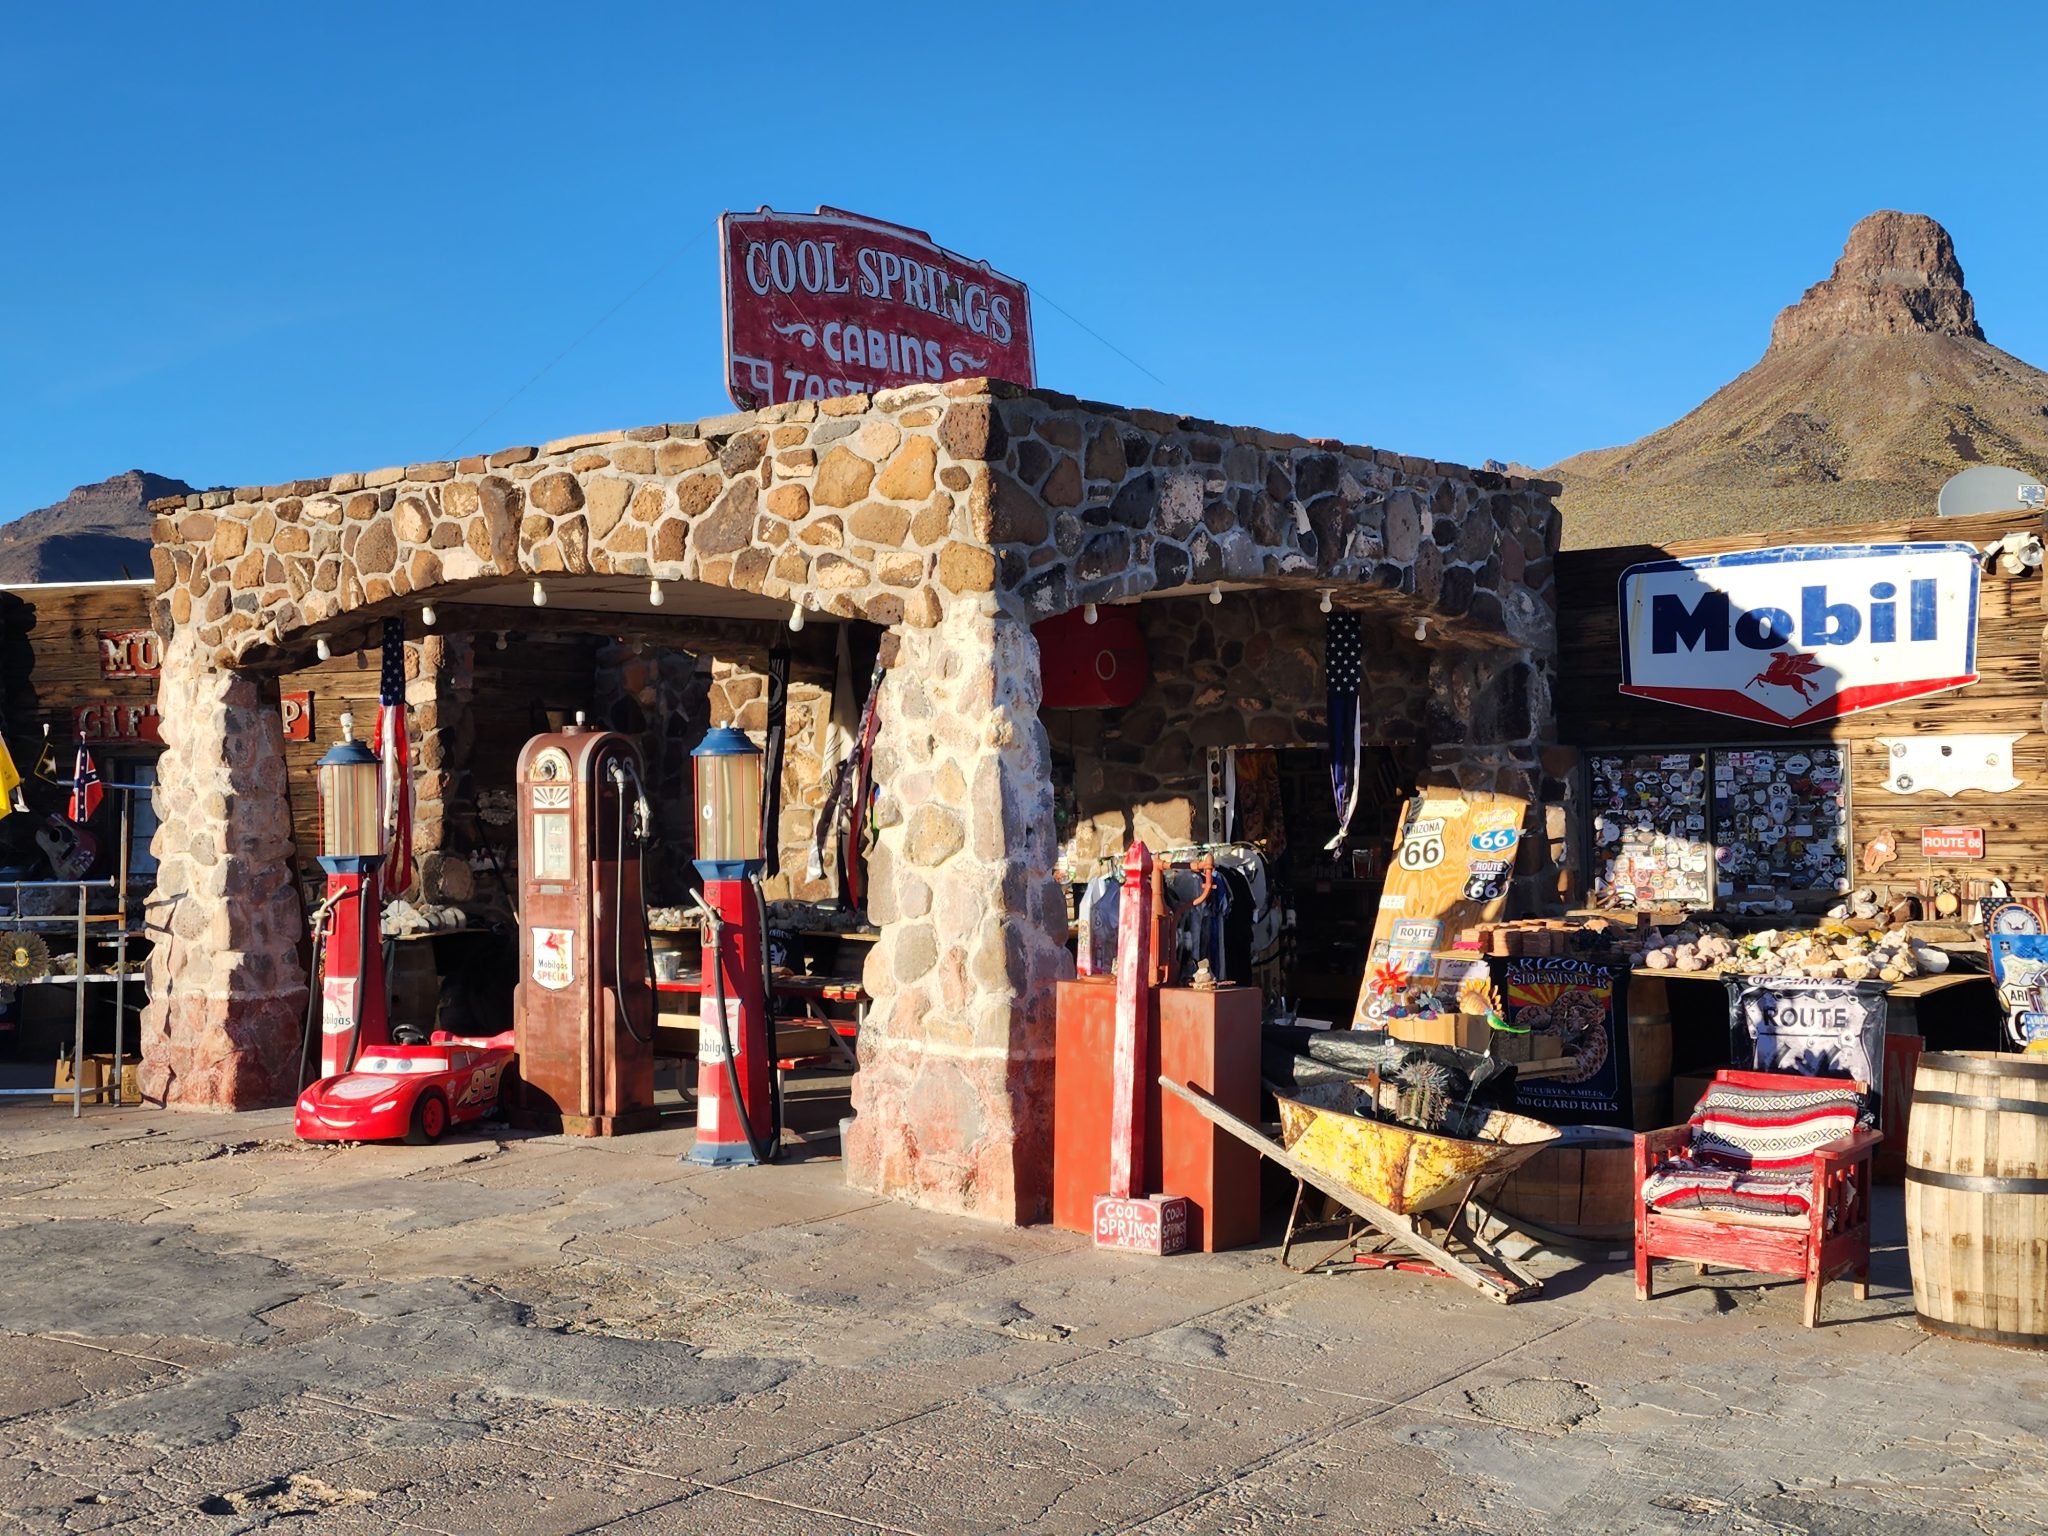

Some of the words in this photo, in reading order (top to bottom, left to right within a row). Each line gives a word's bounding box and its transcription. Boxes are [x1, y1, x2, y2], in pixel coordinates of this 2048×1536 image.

[745, 239, 849, 296] COOL
[856, 246, 1013, 345] SPRINGS
[822, 321, 943, 381] CABINS
[1652, 578, 1938, 655] Mobil
[1772, 785, 1788, 795] SK
[1405, 822, 1440, 836] ARIZONA
[1480, 830, 1508, 849] 66
[1924, 837, 1965, 848] ROUTE
[1968, 838, 1981, 849] 66
[1404, 838, 1439, 866] 66
[1475, 861, 1503, 872] ROUTE
[1470, 880, 1498, 898] 66
[1400, 927, 1435, 938] ROUTE
[538, 959, 568, 972] Mobilgas
[1505, 958, 1614, 979] ARIZONA
[537, 970, 569, 982] SPECIAL
[1512, 972, 1608, 989] SIDEWINDER
[1762, 1007, 1847, 1028] ROUTE
[471, 1065, 497, 1105] 95
[1516, 1096, 1531, 1105] NO
[1533, 1098, 1578, 1109] GUARD
[1581, 1102, 1618, 1111] RAILS
[1105, 1203, 1142, 1220] COOL
[1165, 1206, 1183, 1222] COOL
[1099, 1218, 1157, 1239] SPRINGS
[1117, 1236, 1129, 1246] AZ
[1134, 1238, 1151, 1248] USA
